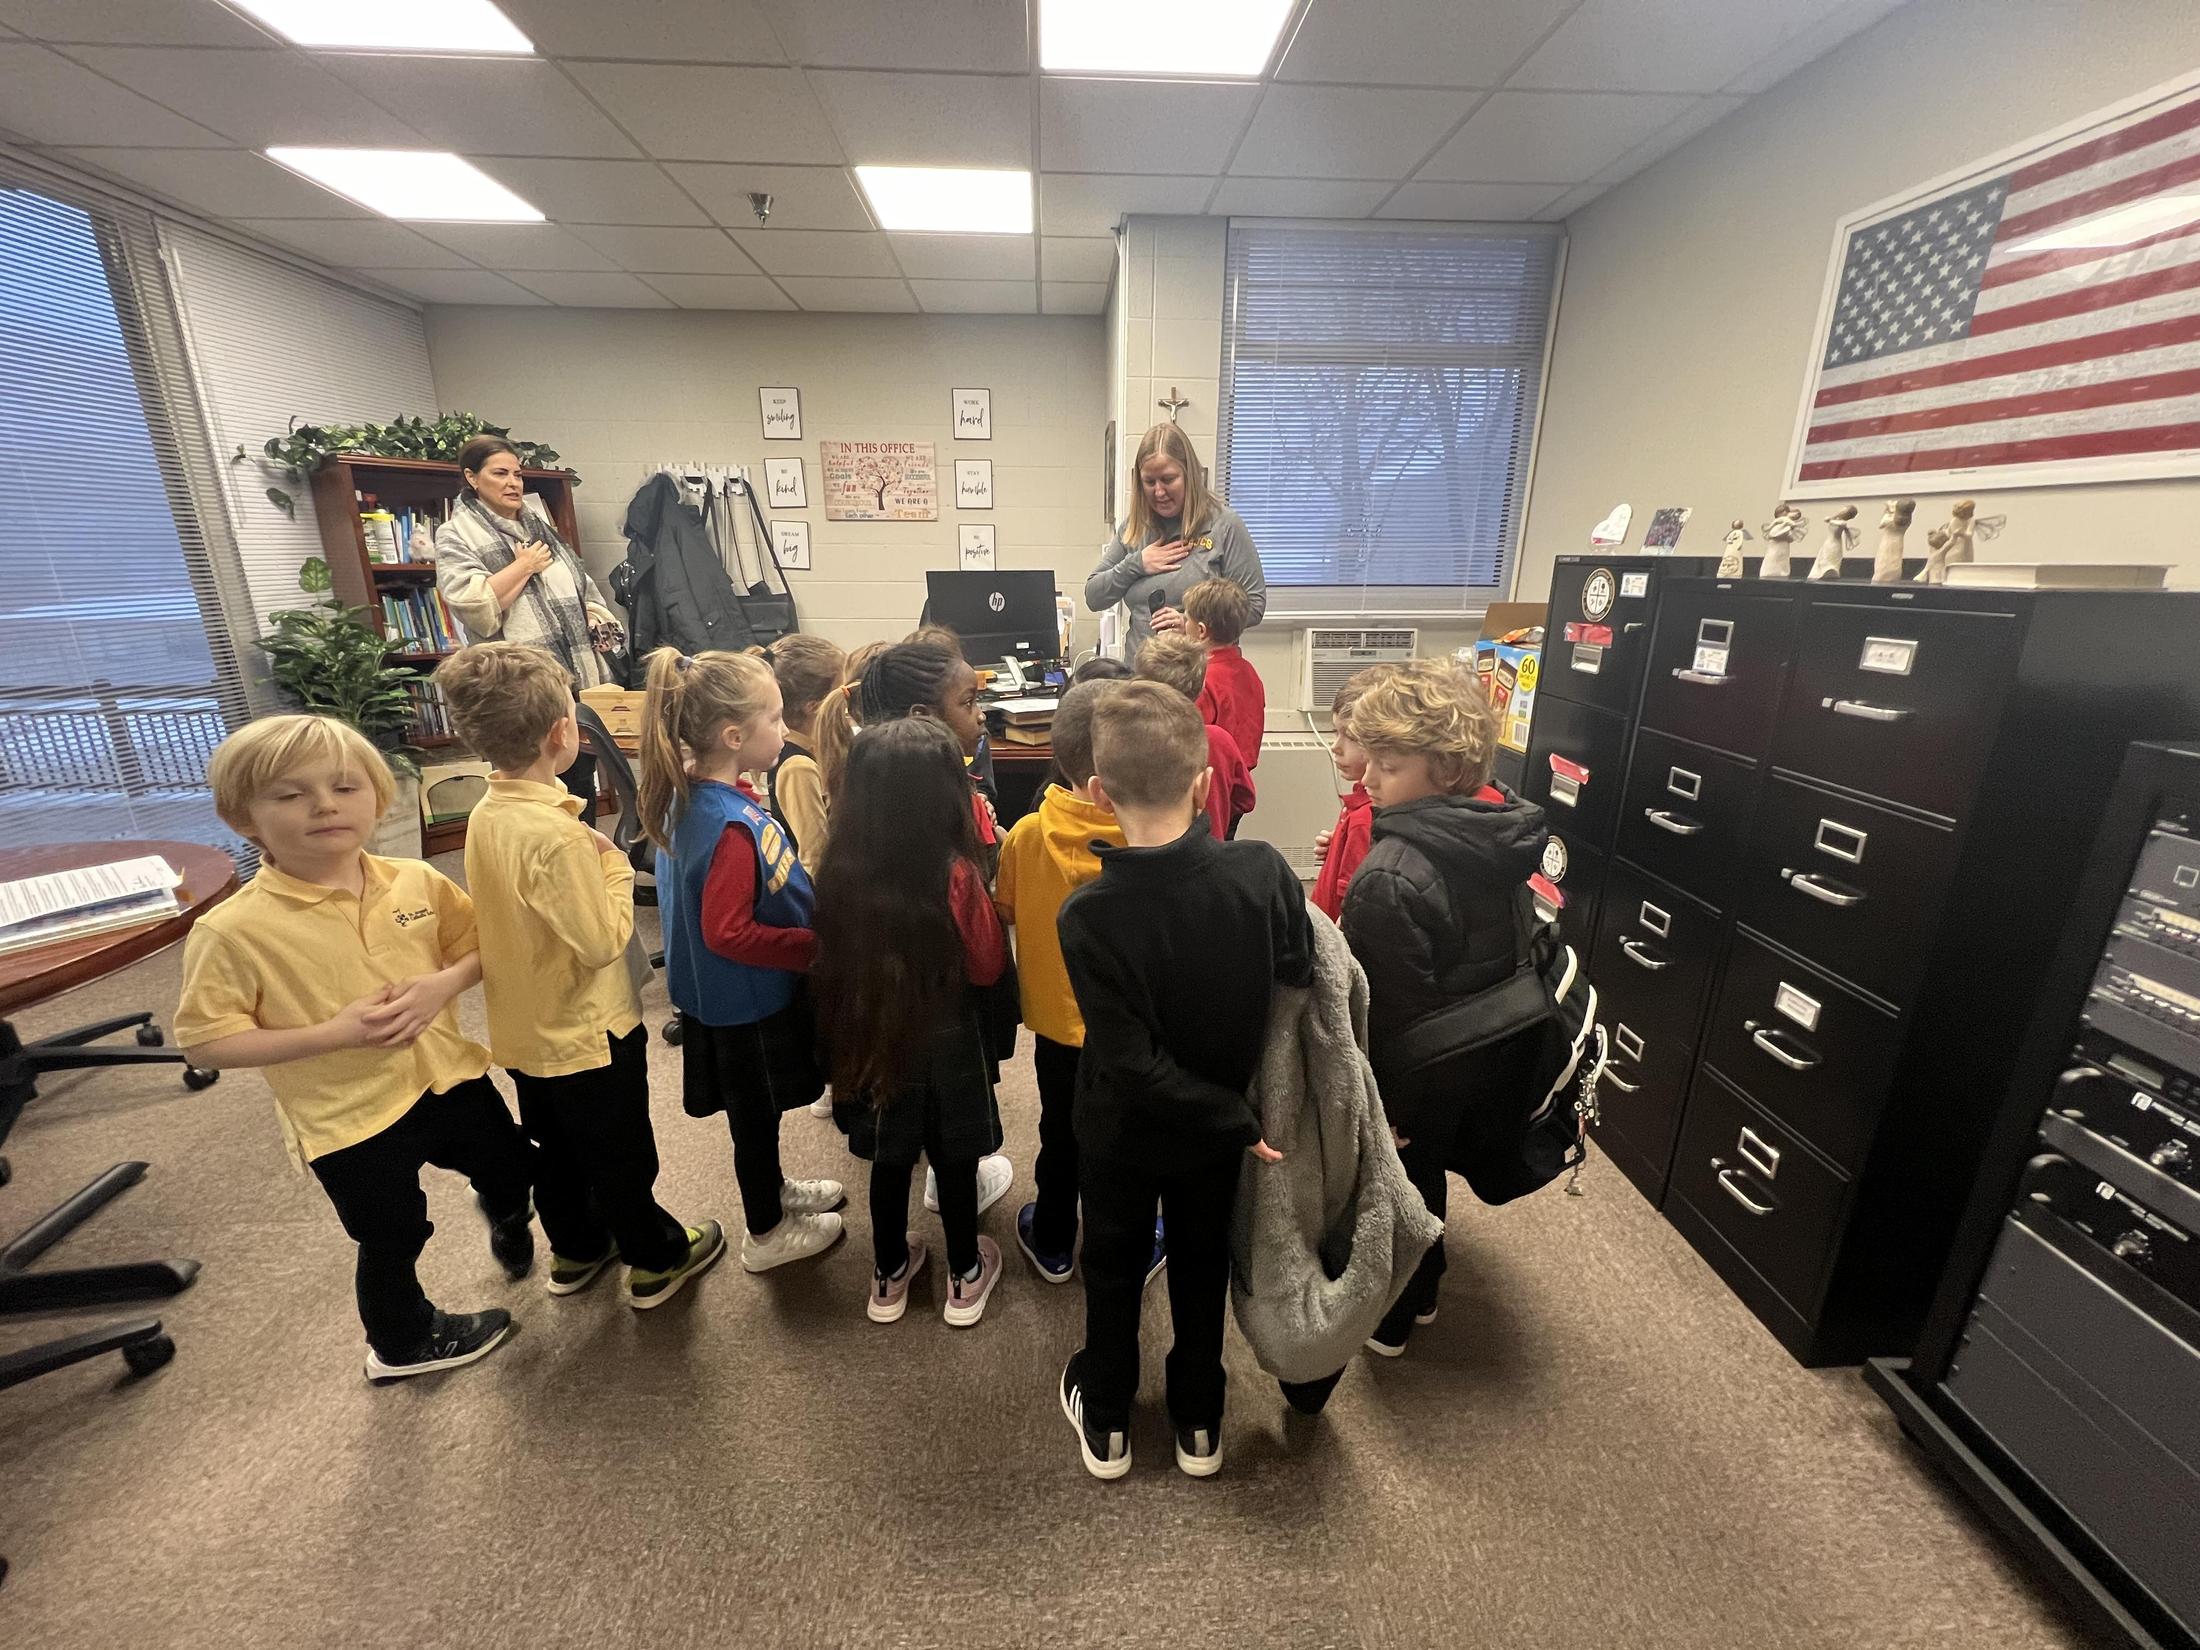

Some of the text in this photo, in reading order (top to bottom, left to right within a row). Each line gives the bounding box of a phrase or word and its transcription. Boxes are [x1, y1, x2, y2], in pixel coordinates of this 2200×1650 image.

[766, 408, 795, 430] smiling
[960, 407, 983, 428] hard
[840, 442, 916, 454] IN THIS OFFICE
[776, 476, 798, 497] kind
[961, 481, 988, 495] humble
[783, 539, 799, 563] big
[965, 543, 991, 560] positive
[1521, 658, 1536, 675] 60
